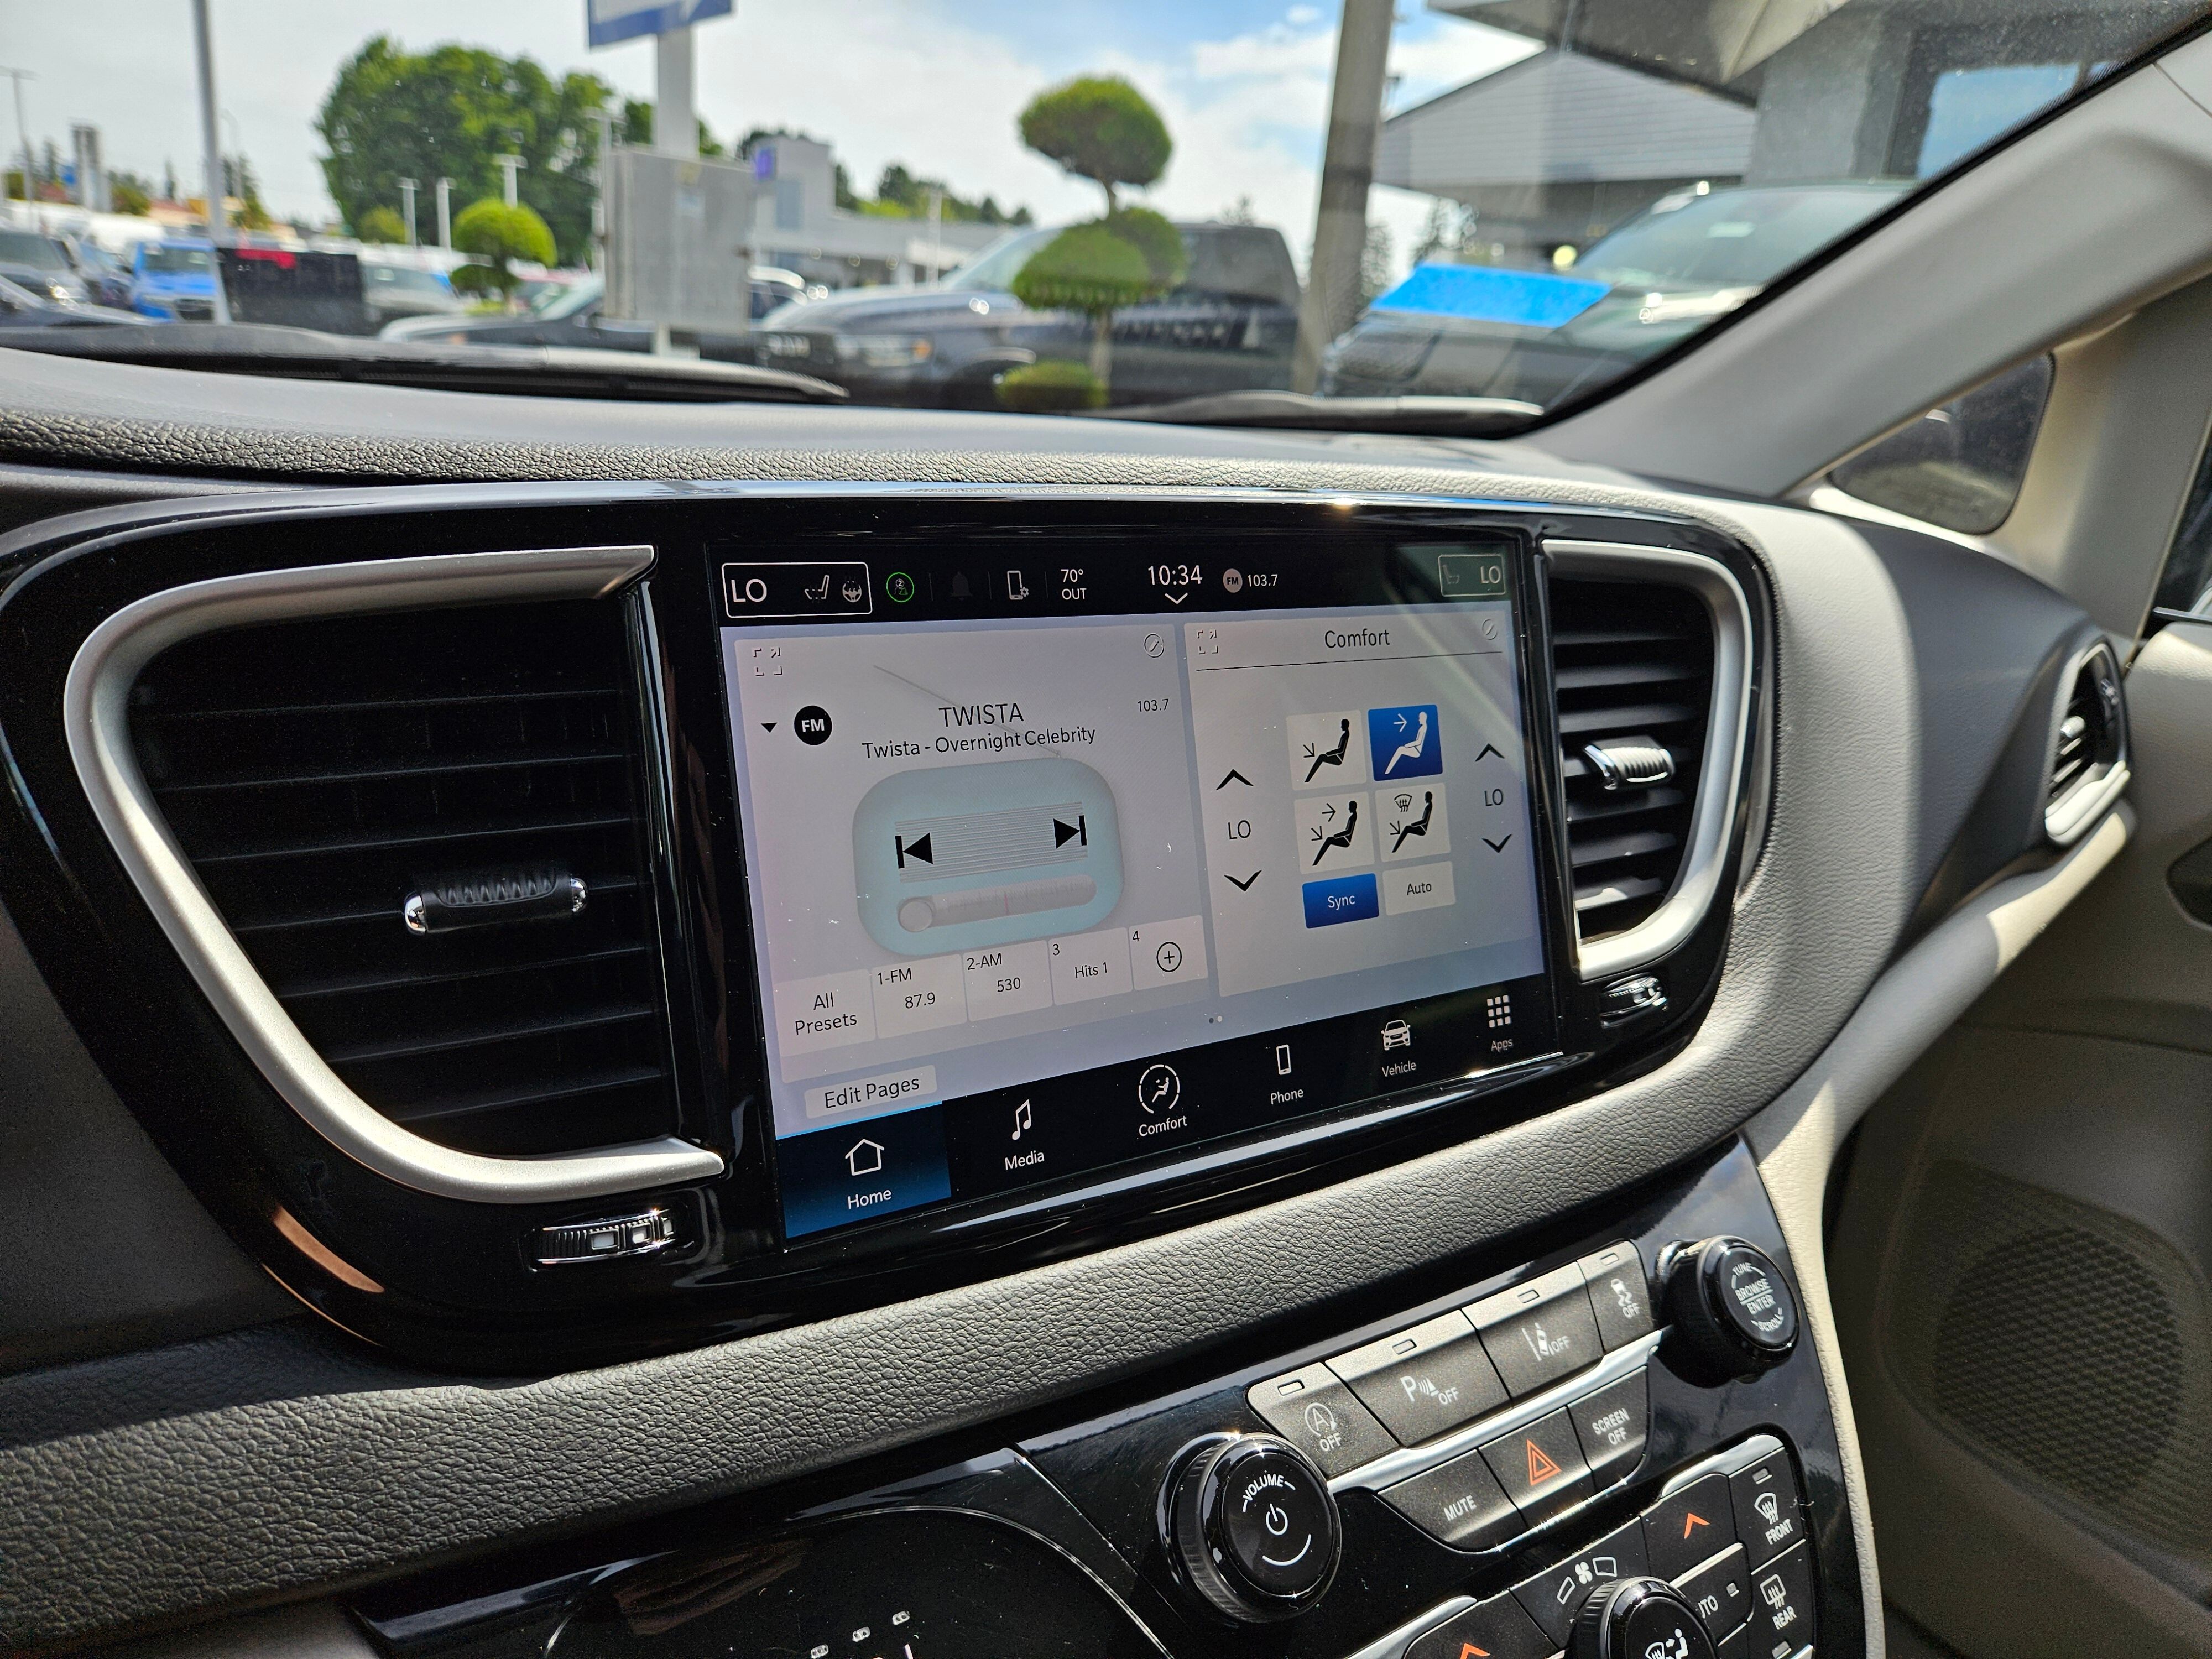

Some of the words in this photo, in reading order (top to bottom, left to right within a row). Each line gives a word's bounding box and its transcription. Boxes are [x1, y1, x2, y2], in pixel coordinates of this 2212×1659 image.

[1061, 568, 1084, 583] 70°
[1147, 565, 1202, 586] 10:34
[1227, 576, 1239, 586] FM
[1247, 574, 1278, 587] 103.7
[1480, 565, 1500, 584] LO
[731, 578, 767, 603] LO
[1062, 588, 1087, 600] OUT
[1324, 628, 1390, 648] Comfort
[1138, 698, 1169, 712] 103.7
[939, 703, 1024, 727] TWISTA
[802, 718, 825, 732] FM
[862, 740, 920, 759] Twista
[935, 732, 1021, 754] Overnight
[1025, 727, 1095, 747] Celebrity
[1485, 789, 1504, 806] LO
[1228, 821, 1251, 840] LO
[1407, 881, 1432, 895] Auto
[1328, 894, 1355, 910] Sync
[1132, 931, 1140, 942] 4
[1053, 944, 1060, 956] 3
[967, 953, 1003, 971] 2-AM
[1074, 964, 1099, 979] Hits
[1102, 962, 1108, 974] 1
[877, 968, 912, 985] 1-FM
[997, 977, 1021, 992] 530
[813, 993, 834, 1010] All
[905, 992, 936, 1009] 87.9
[795, 1013, 857, 1036] Presets
[1491, 1037, 1512, 1053] Apps
[1382, 1060, 1416, 1077] Vehicle
[825, 1088, 861, 1109] Edit
[867, 1077, 920, 1103] Pages
[1270, 1087, 1304, 1104] Phone
[1139, 1115, 1187, 1138] Comfort
[1005, 1150, 1045, 1171] Media
[847, 1188, 892, 1209] Home
[1732, 1262, 1752, 1277] TUNE
[1735, 1278, 1771, 1301] BROWSE
[1623, 1302, 1640, 1318] OFF
[1746, 1294, 1776, 1315] ENTER
[1757, 1314, 1784, 1332] SCROLL
[1551, 1335, 1570, 1354] OFF
[1439, 1387, 1459, 1405] OFF
[1592, 1408, 1630, 1436] SCREEN
[1319, 1434, 1342, 1452] OFF
[1608, 1427, 1627, 1446] OFF
[1243, 1474, 1284, 1501] VOLUME
[1444, 1495, 1476, 1521] MUTE
[1765, 1519, 1793, 1545] FRONT
[1772, 1606, 1797, 1630] REAR
